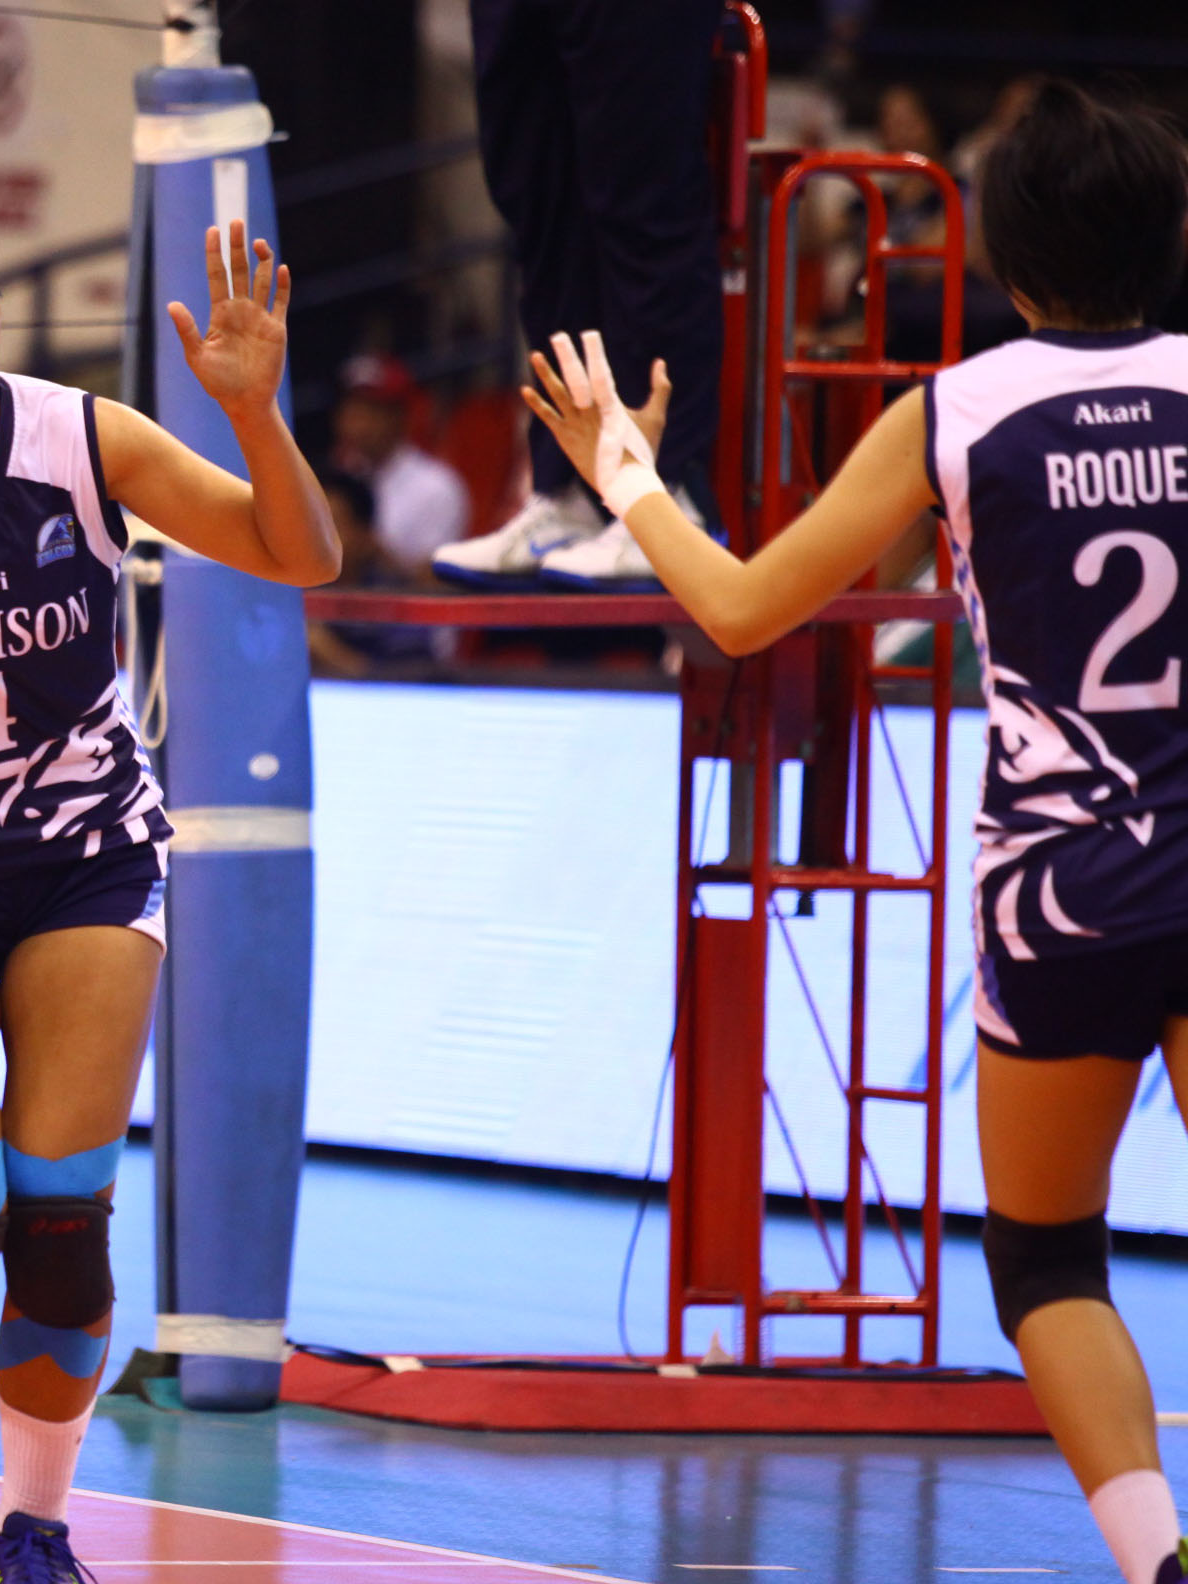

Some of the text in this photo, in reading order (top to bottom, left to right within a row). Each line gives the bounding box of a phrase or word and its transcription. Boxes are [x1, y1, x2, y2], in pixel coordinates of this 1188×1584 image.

[1074, 399, 1153, 425] Akari
[1045, 445, 1188, 510] ROQUE
[1073, 529, 1182, 713] 2
